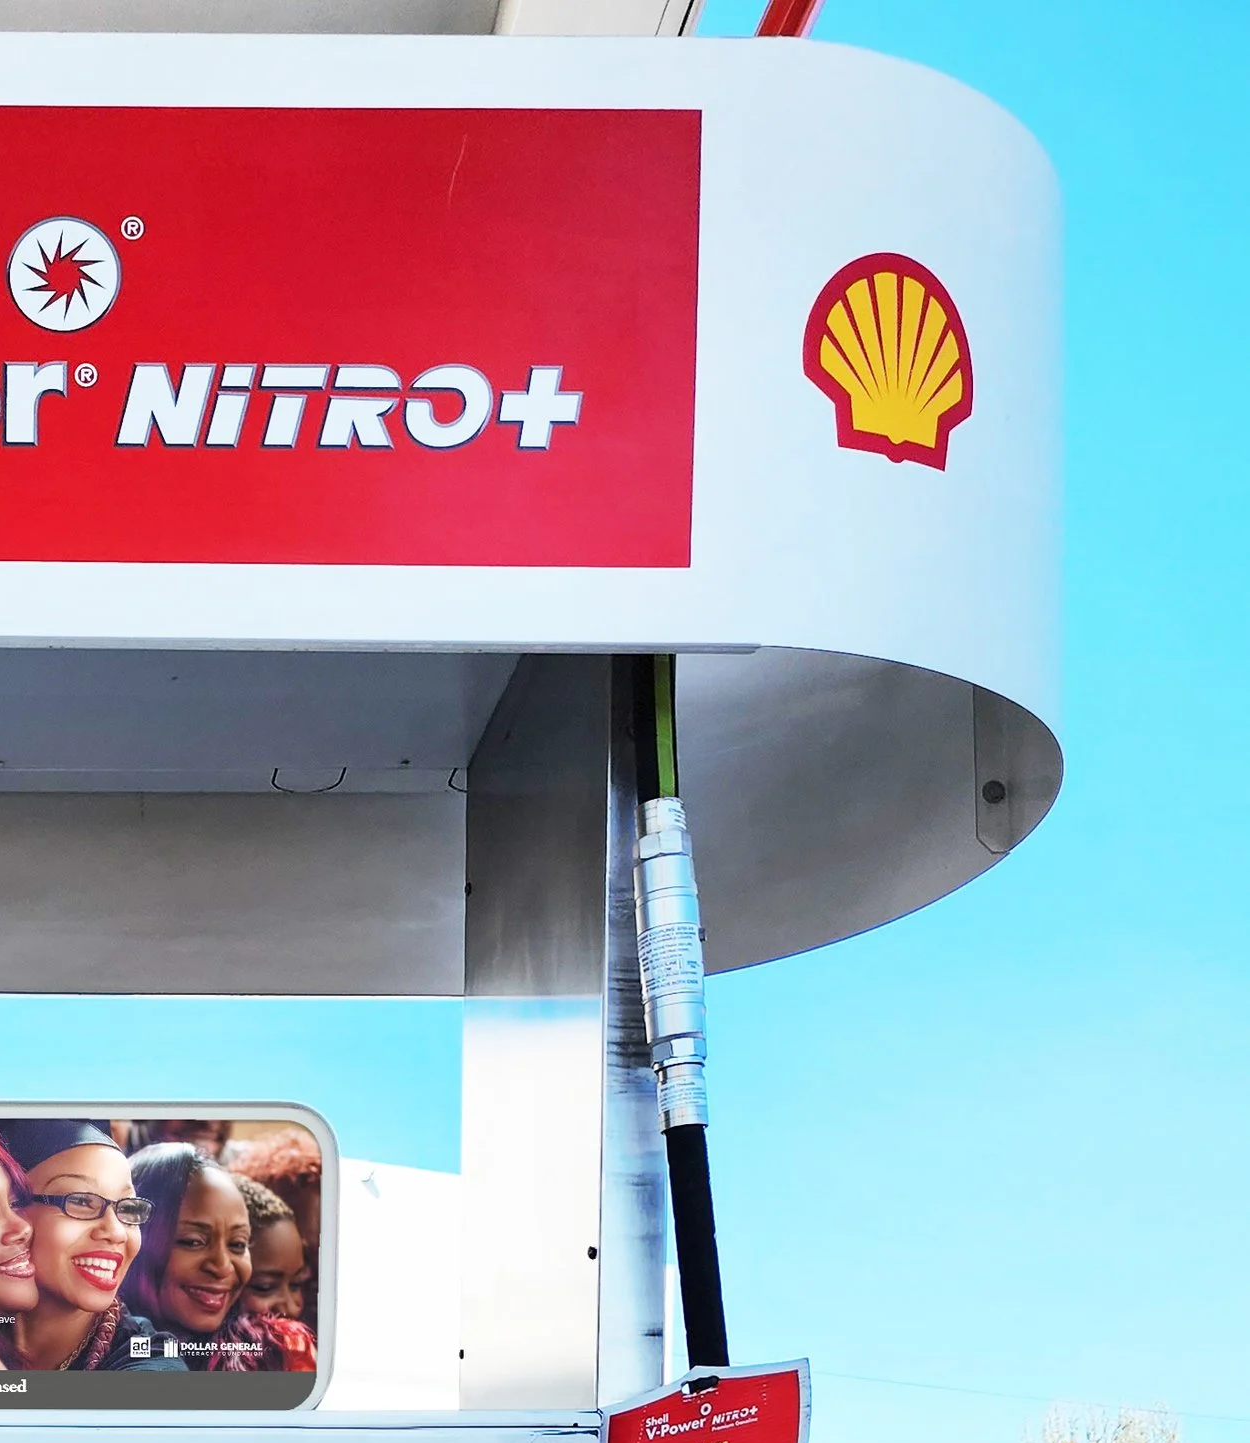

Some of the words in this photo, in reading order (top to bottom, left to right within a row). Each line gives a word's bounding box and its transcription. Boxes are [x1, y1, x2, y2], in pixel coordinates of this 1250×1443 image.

[180, 1342, 218, 1351] DOLLAR
[220, 1342, 263, 1351] GENERAL
[645, 1413, 669, 1428] Shell
[645, 1417, 707, 1440] V-Power
